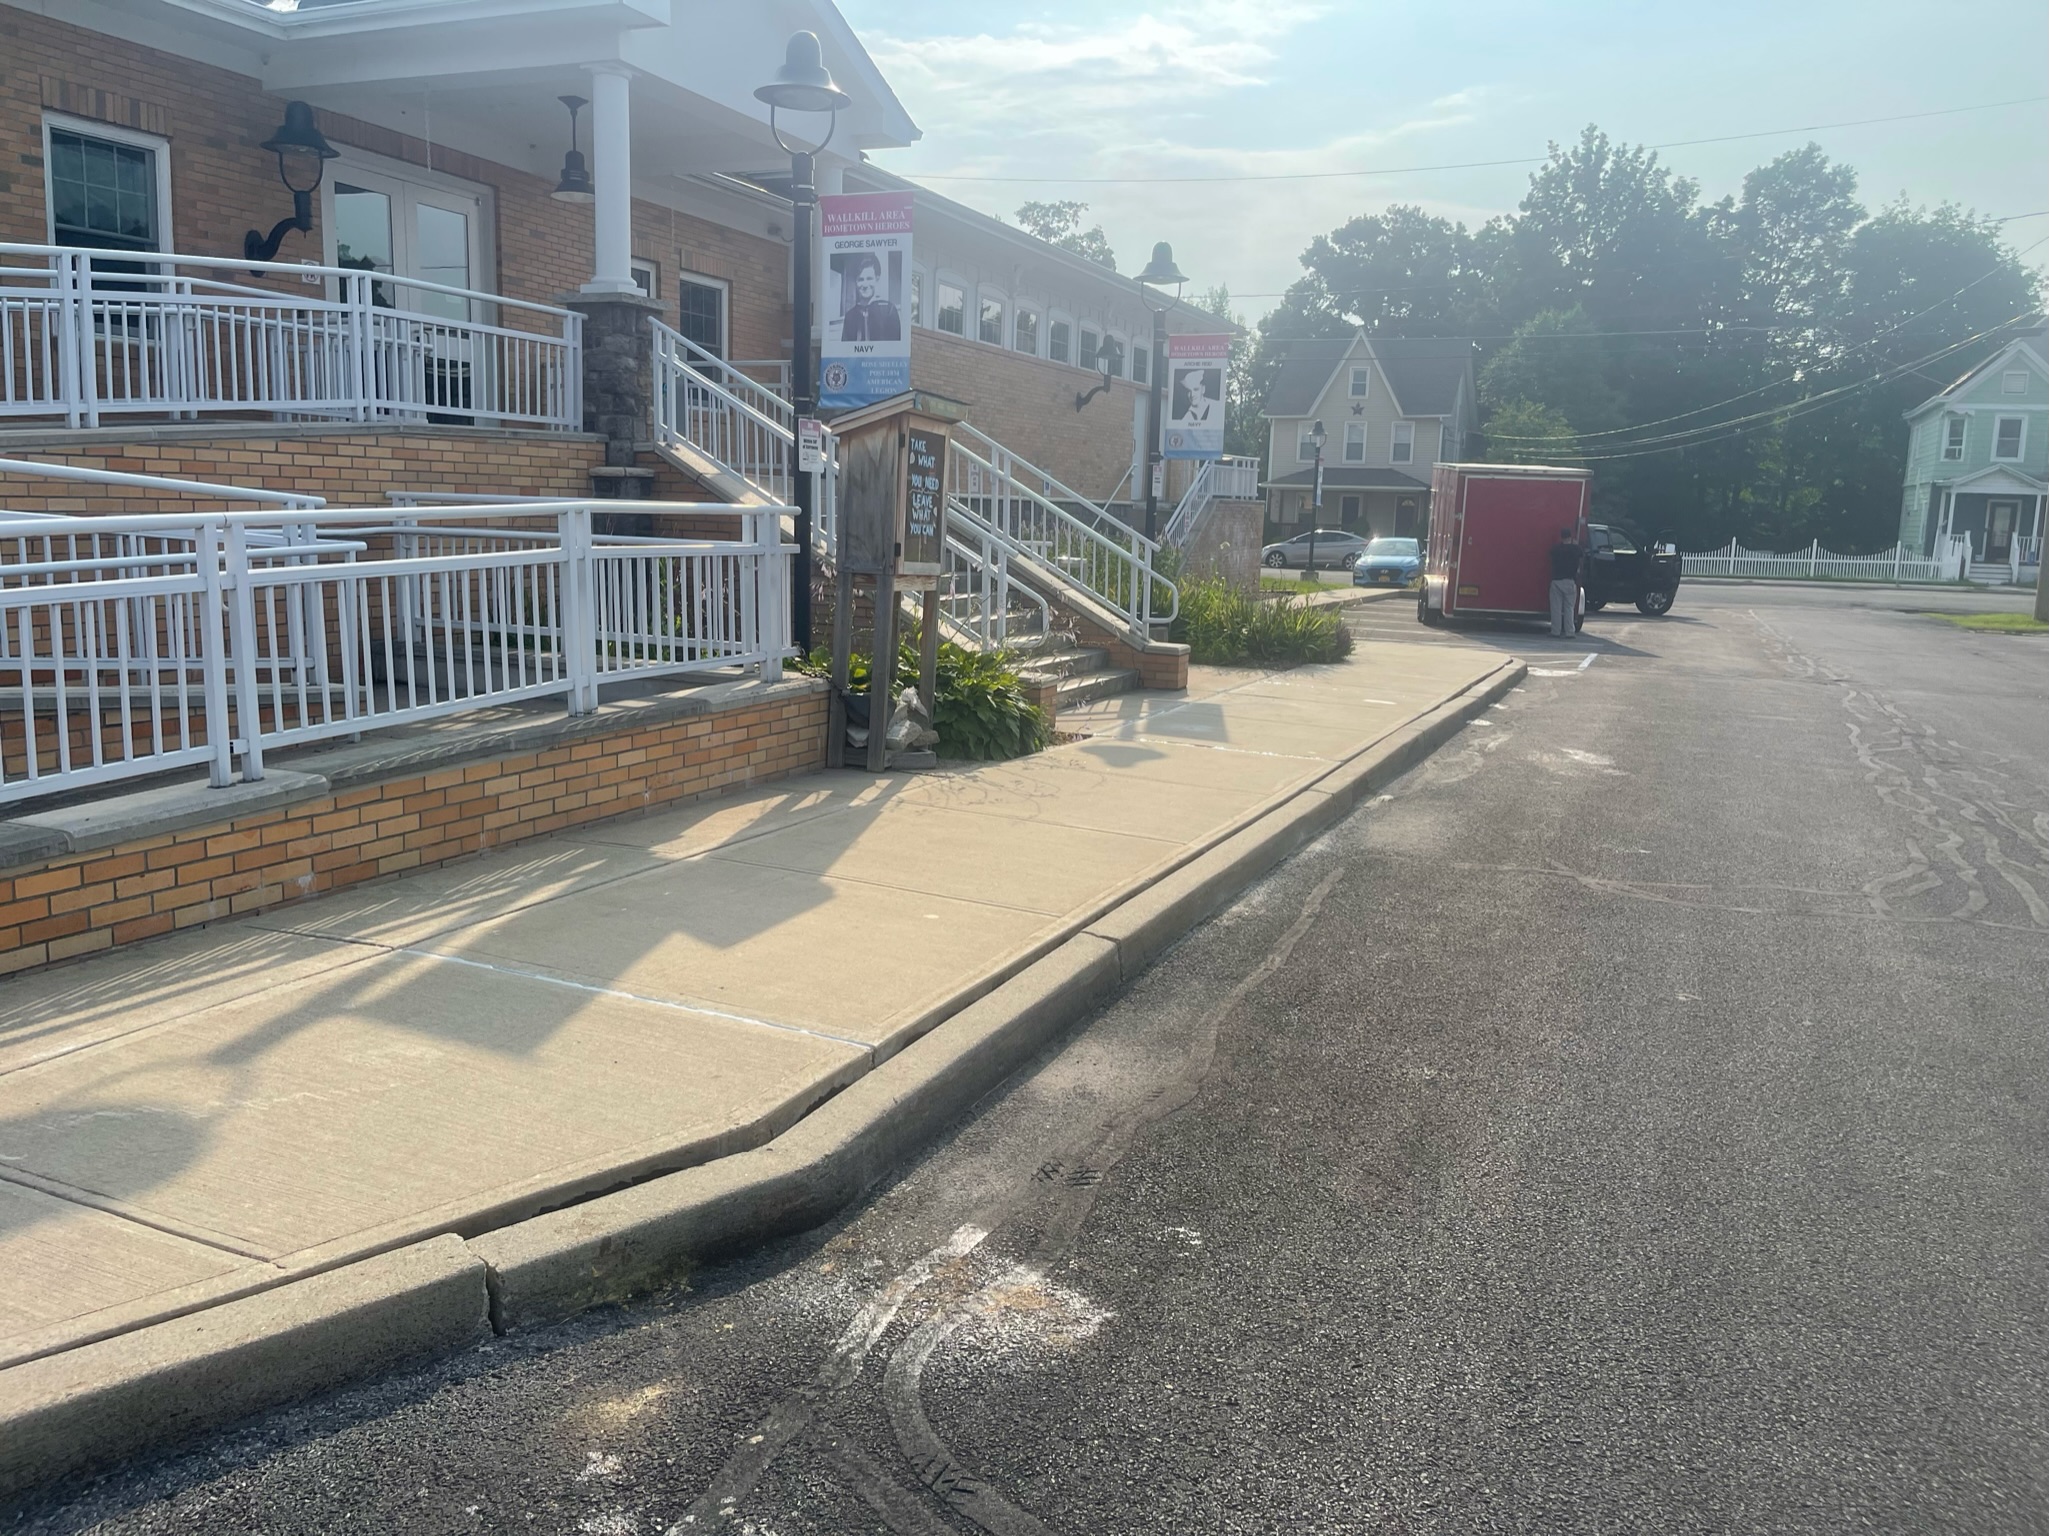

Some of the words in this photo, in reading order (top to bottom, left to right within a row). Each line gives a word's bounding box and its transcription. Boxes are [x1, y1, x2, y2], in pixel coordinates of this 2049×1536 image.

[827, 211, 877, 223] WALLKILL
[879, 210, 905, 220] AREA
[824, 223, 873, 233] HOMETOWN
[875, 221, 910, 231] HEROES
[834, 240, 864, 249] GEORGE
[865, 239, 898, 248] SAWYER
[854, 345, 874, 353] NAVY
[911, 437, 927, 453] TAKE
[918, 454, 935, 469] WHAT
[911, 473, 922, 488] YOU
[925, 475, 940, 491] NEED
[912, 492, 933, 508] LEAVE
[911, 507, 931, 521] WHAT
[910, 521, 922, 535] YOU
[922, 524, 934, 537] CAN
